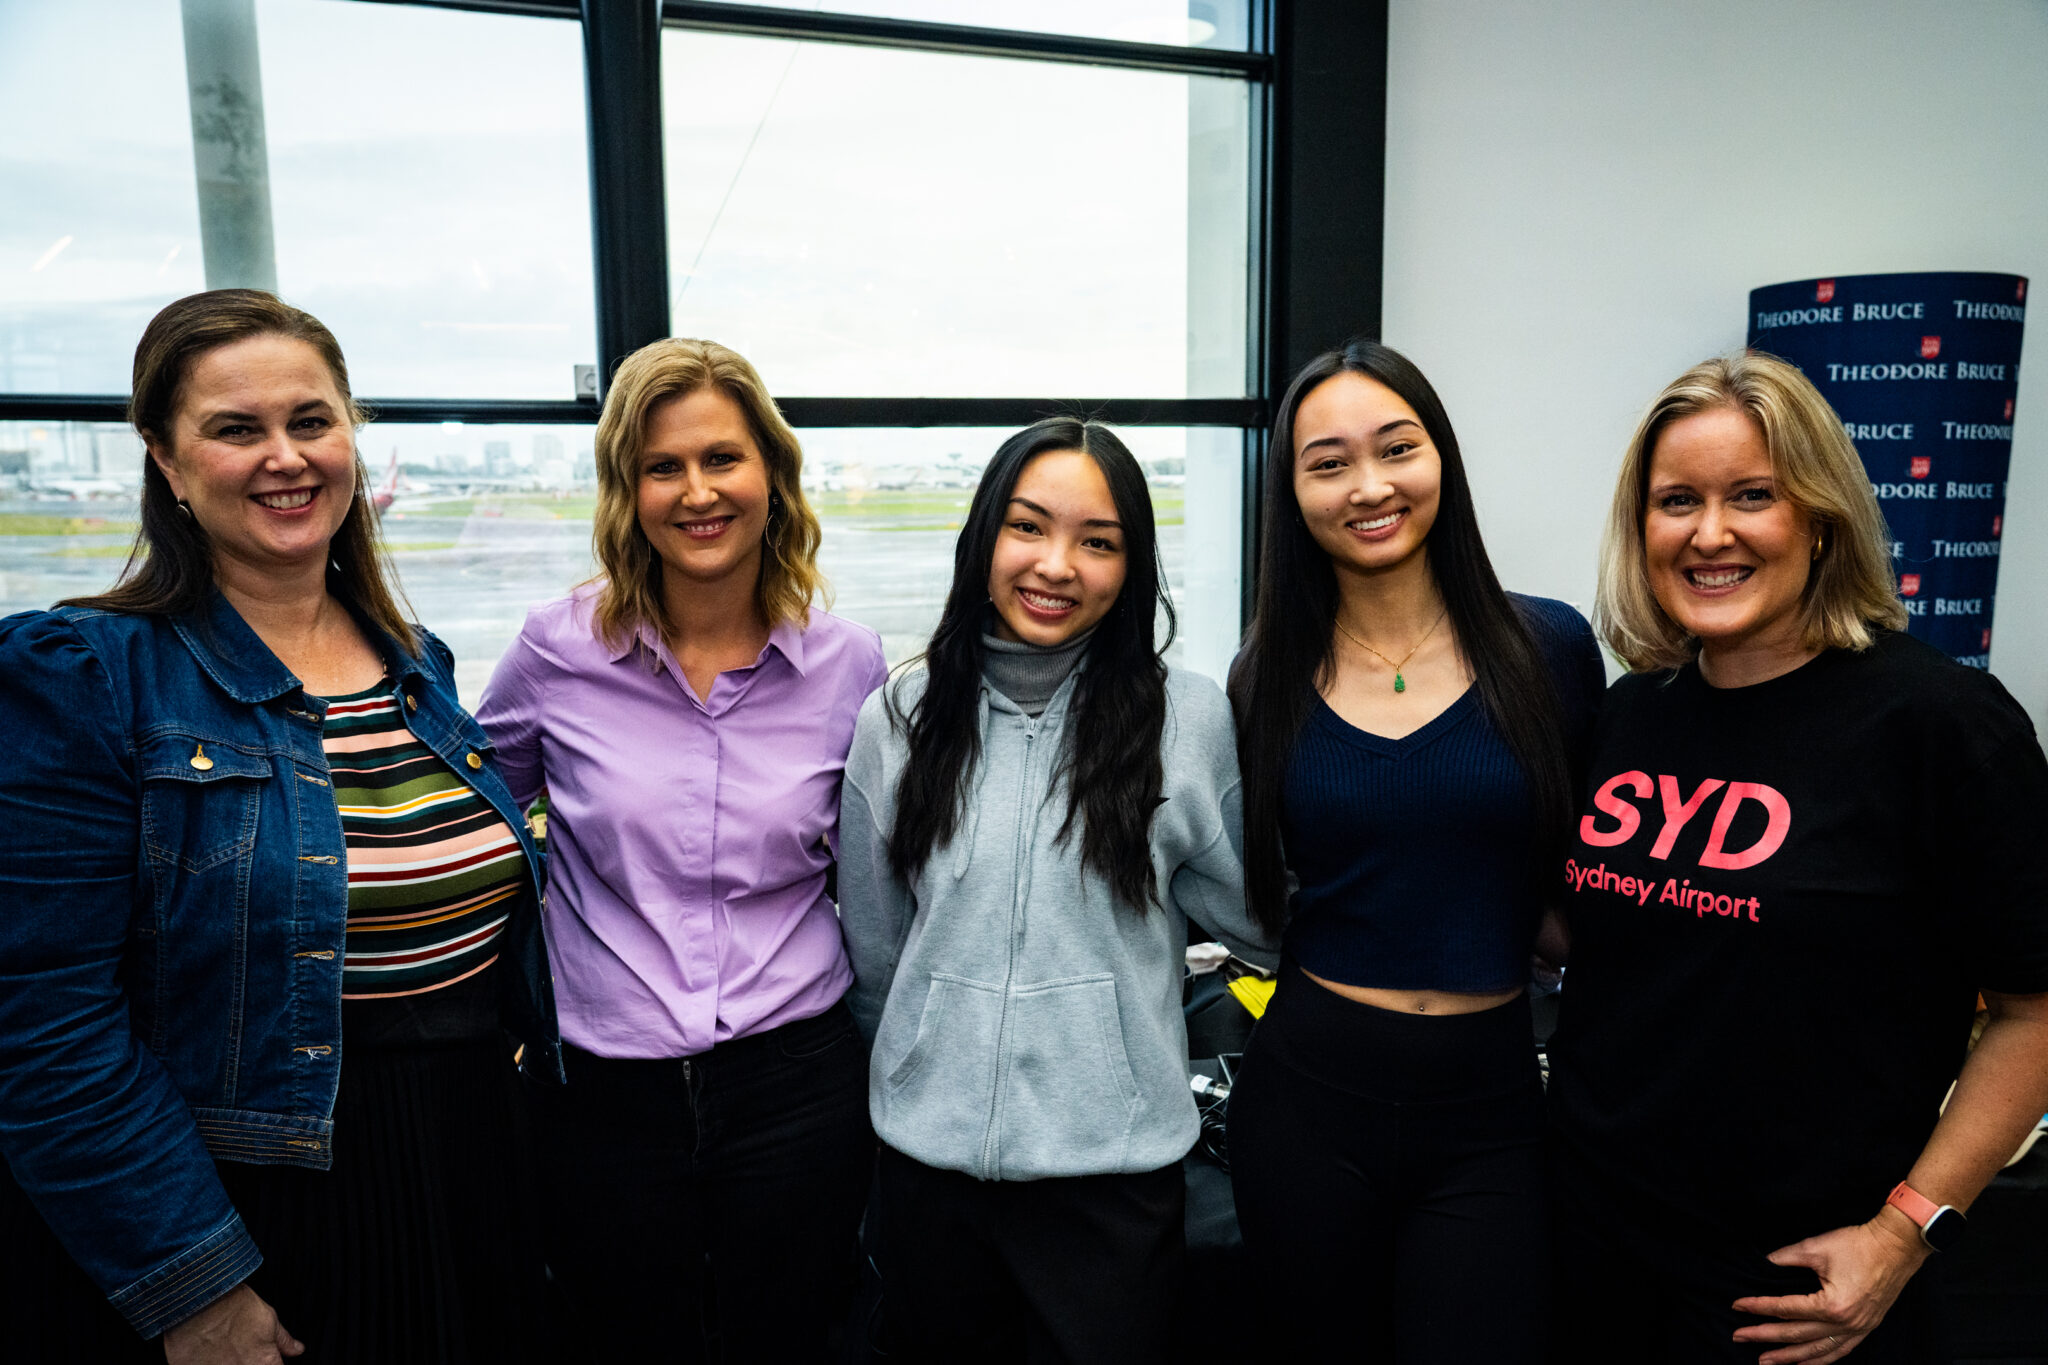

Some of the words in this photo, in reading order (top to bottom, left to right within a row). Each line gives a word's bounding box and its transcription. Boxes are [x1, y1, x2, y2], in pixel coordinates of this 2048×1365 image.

[1757, 306, 1844, 330] THEODORE
[1852, 302, 1925, 321] BRUCE
[1827, 363, 1949, 382] THEODORE
[1956, 361, 2006, 381] BRUCE
[1843, 422, 1914, 440] BRUCE
[1945, 481, 1993, 499] BRUCE
[1934, 598, 1982, 616] BRUCE
[1579, 770, 1791, 870] SYD
[1565, 858, 1656, 906] Sydney
[1658, 879, 1760, 922] Airport
